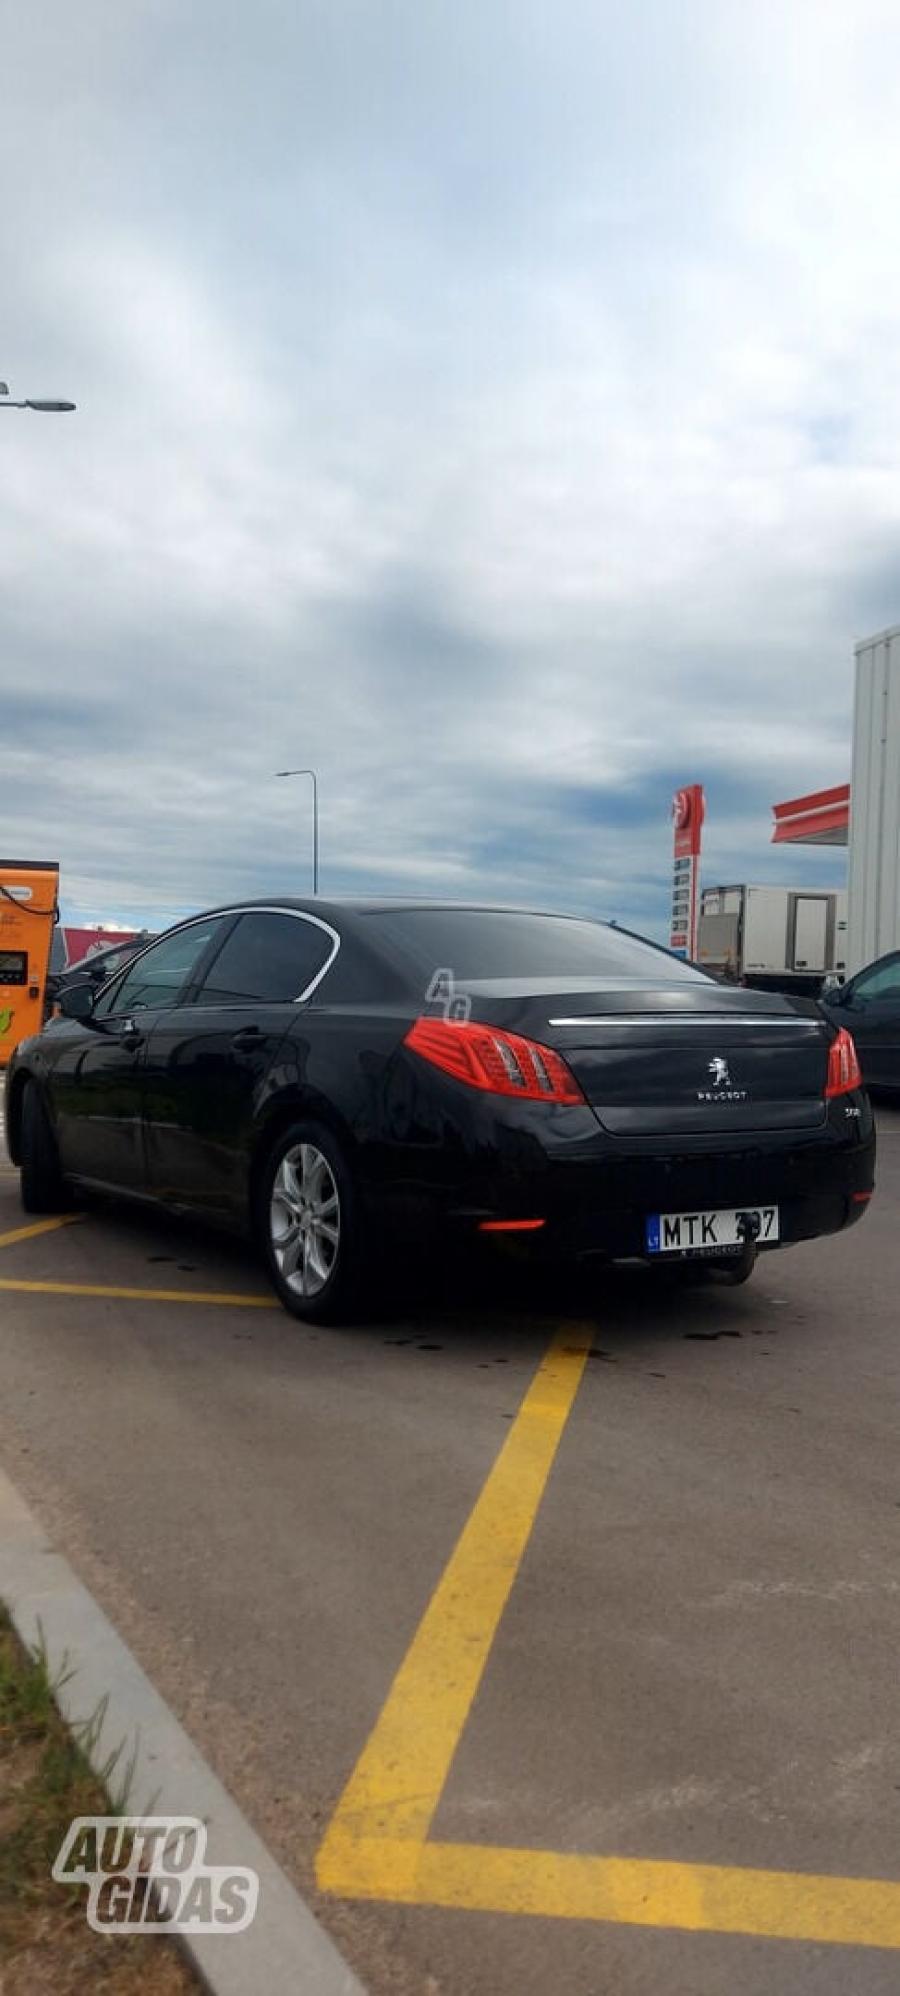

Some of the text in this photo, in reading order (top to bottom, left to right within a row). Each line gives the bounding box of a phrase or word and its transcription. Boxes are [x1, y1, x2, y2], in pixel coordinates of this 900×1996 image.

[697, 1091, 748, 1101] PEUGEOT
[663, 1214, 718, 1247] MTK
[648, 1236, 659, 1247] LT
